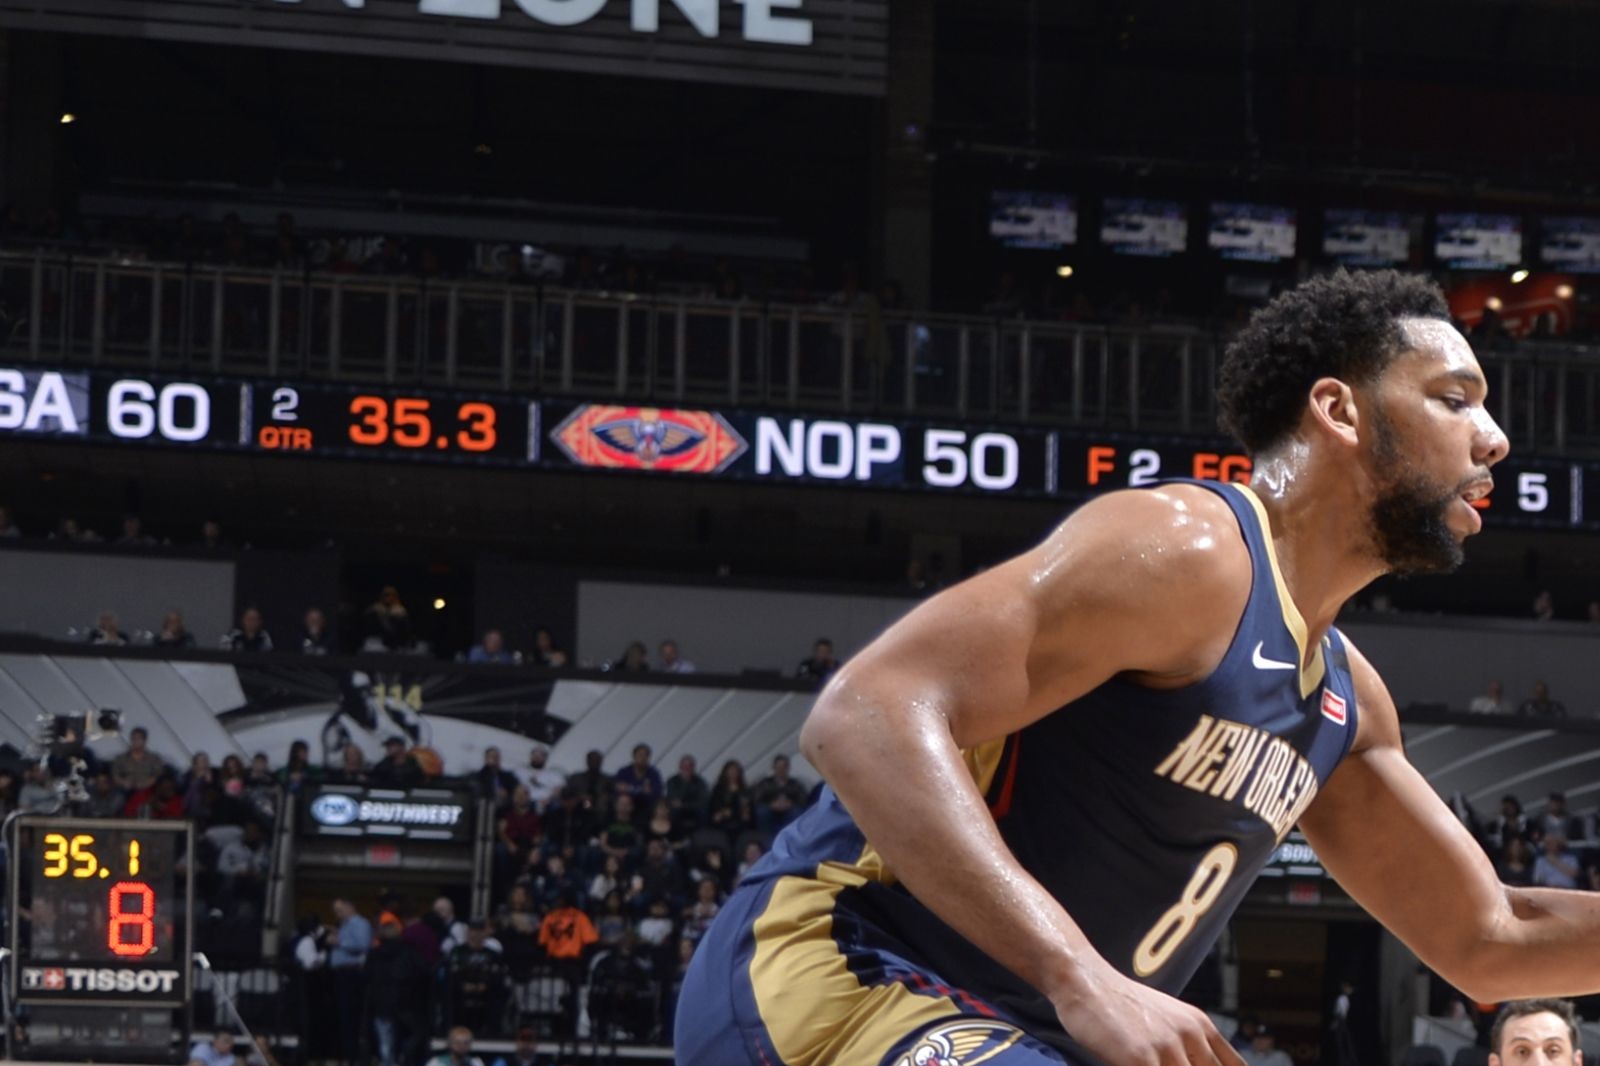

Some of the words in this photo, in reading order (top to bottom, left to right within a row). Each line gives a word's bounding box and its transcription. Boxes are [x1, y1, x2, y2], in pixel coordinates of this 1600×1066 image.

[107, 380, 211, 441] 60
[272, 387, 299, 421] 2
[348, 396, 497, 452] 35.3
[755, 416, 901, 481] NOP
[922, 428, 1019, 490] 50
[1087, 446, 1116, 486] F
[1128, 448, 1161, 488] 2
[1517, 472, 1549, 512] 5
[1153, 713, 1271, 802] NEW
[359, 801, 463, 825] SOUTHWEST
[44, 834, 140, 879] 35.1
[108, 882, 155, 956] 8
[1132, 841, 1239, 978] 8
[66, 971, 180, 993] TISSOT
